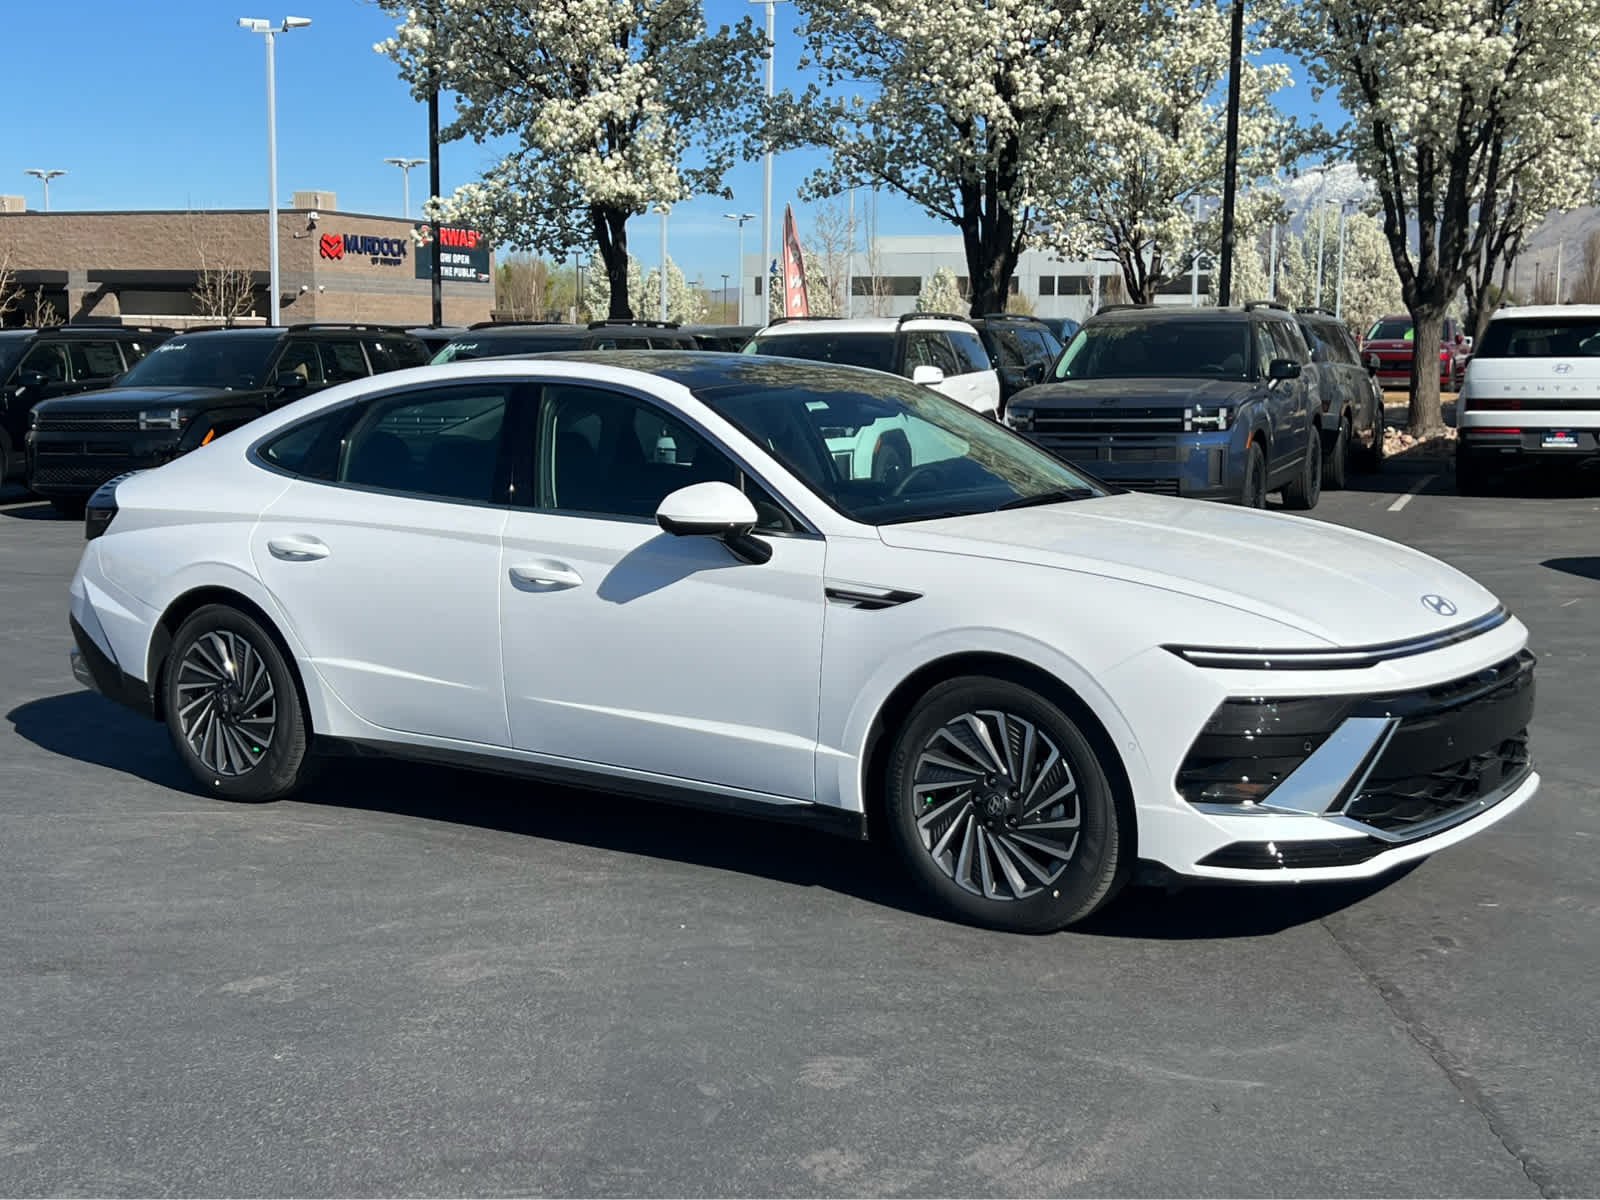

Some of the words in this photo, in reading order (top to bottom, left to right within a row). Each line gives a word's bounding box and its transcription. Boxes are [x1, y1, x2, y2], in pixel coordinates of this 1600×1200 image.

[343, 233, 407, 258] MURDOCK
[452, 253, 470, 265] OPEN
[440, 266, 453, 277] THE
[453, 267, 477, 278] PUBLIC
